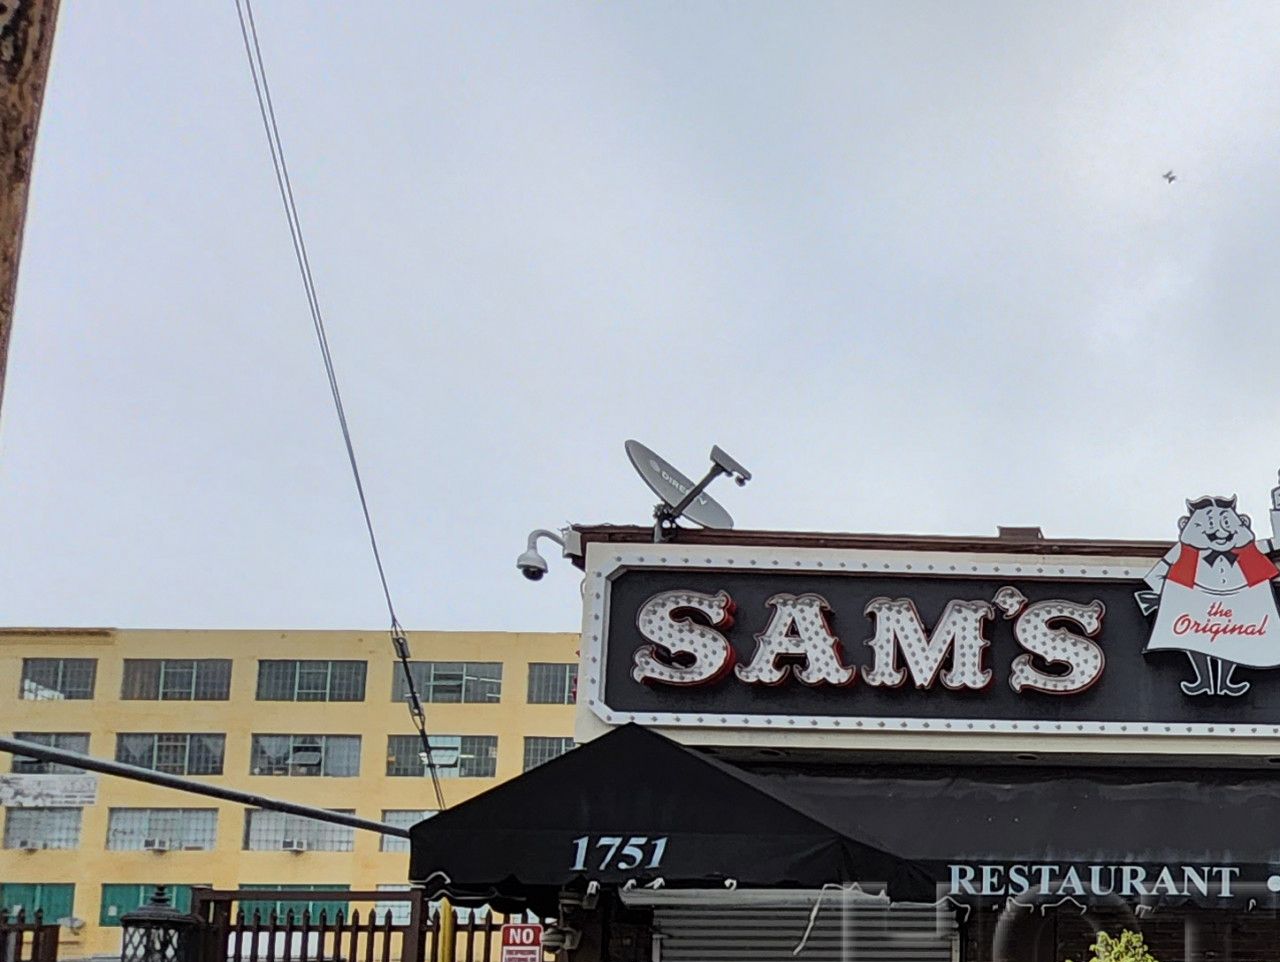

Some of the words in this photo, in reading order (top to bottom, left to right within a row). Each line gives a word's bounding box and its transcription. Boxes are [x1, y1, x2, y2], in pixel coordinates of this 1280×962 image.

[1207, 602, 1232, 618] the
[630, 586, 1106, 696] SAM'S
[1173, 614, 1268, 642] Original
[569, 836, 668, 871] 1751
[947, 864, 1240, 899] RESTAURANT
[509, 929, 534, 944] NO
